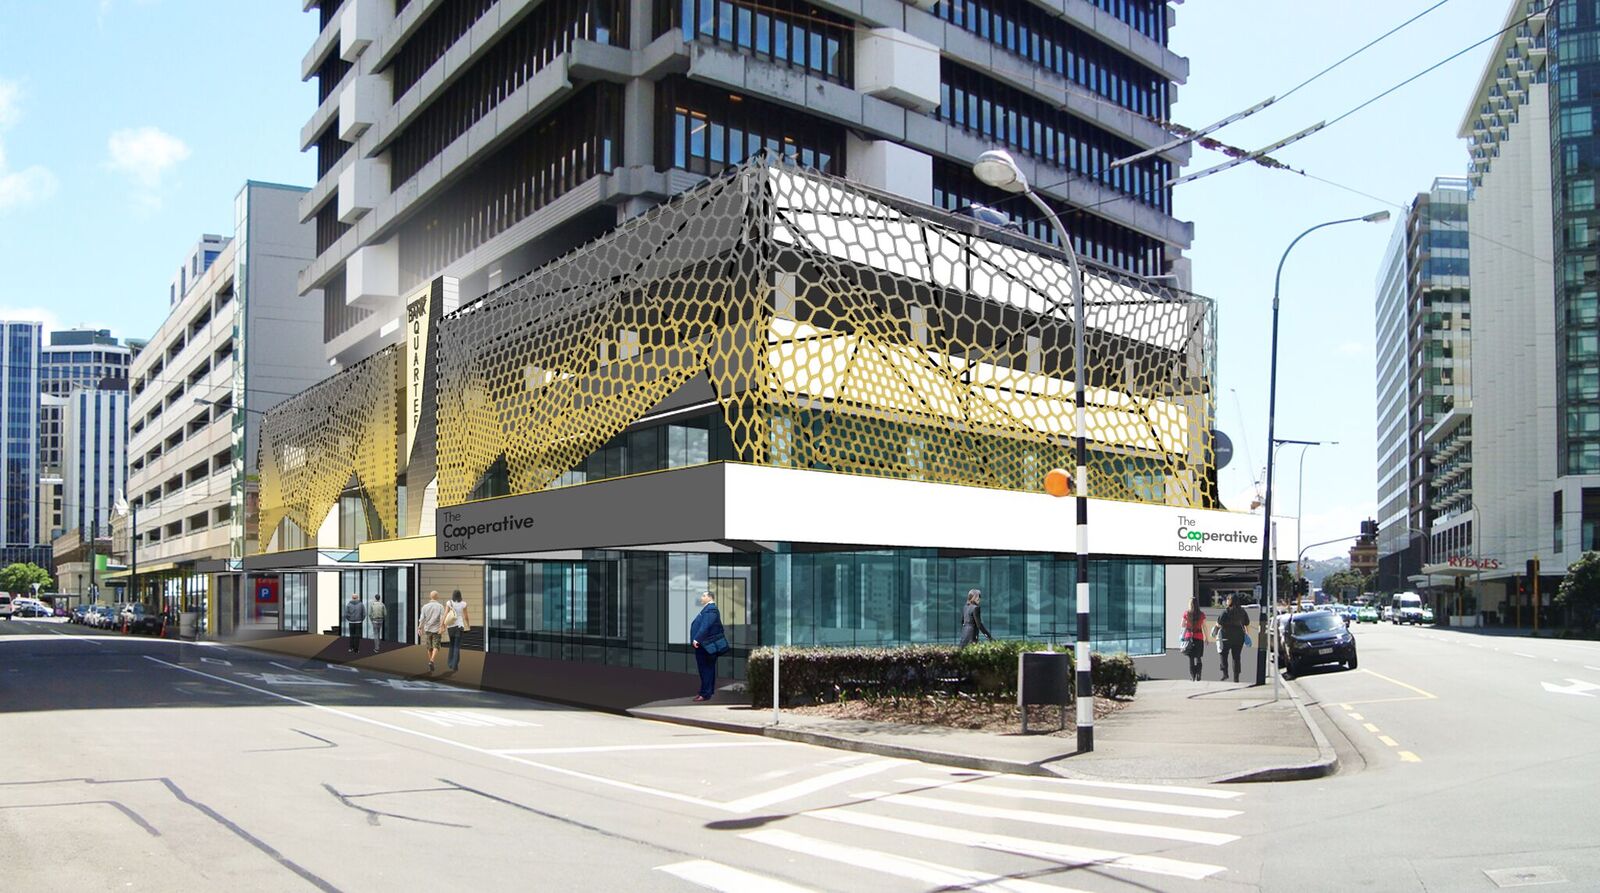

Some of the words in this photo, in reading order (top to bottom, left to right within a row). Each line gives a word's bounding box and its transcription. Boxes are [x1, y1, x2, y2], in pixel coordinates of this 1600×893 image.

[443, 512, 461, 522] The
[1177, 516, 1196, 526] The
[443, 515, 534, 539] Cooperative
[1177, 526, 1258, 544] Cooperative
[443, 540, 468, 552] Bank
[1178, 541, 1202, 552] Bank
[1448, 556, 1499, 570] RYDGES
[262, 588, 270, 599] P
